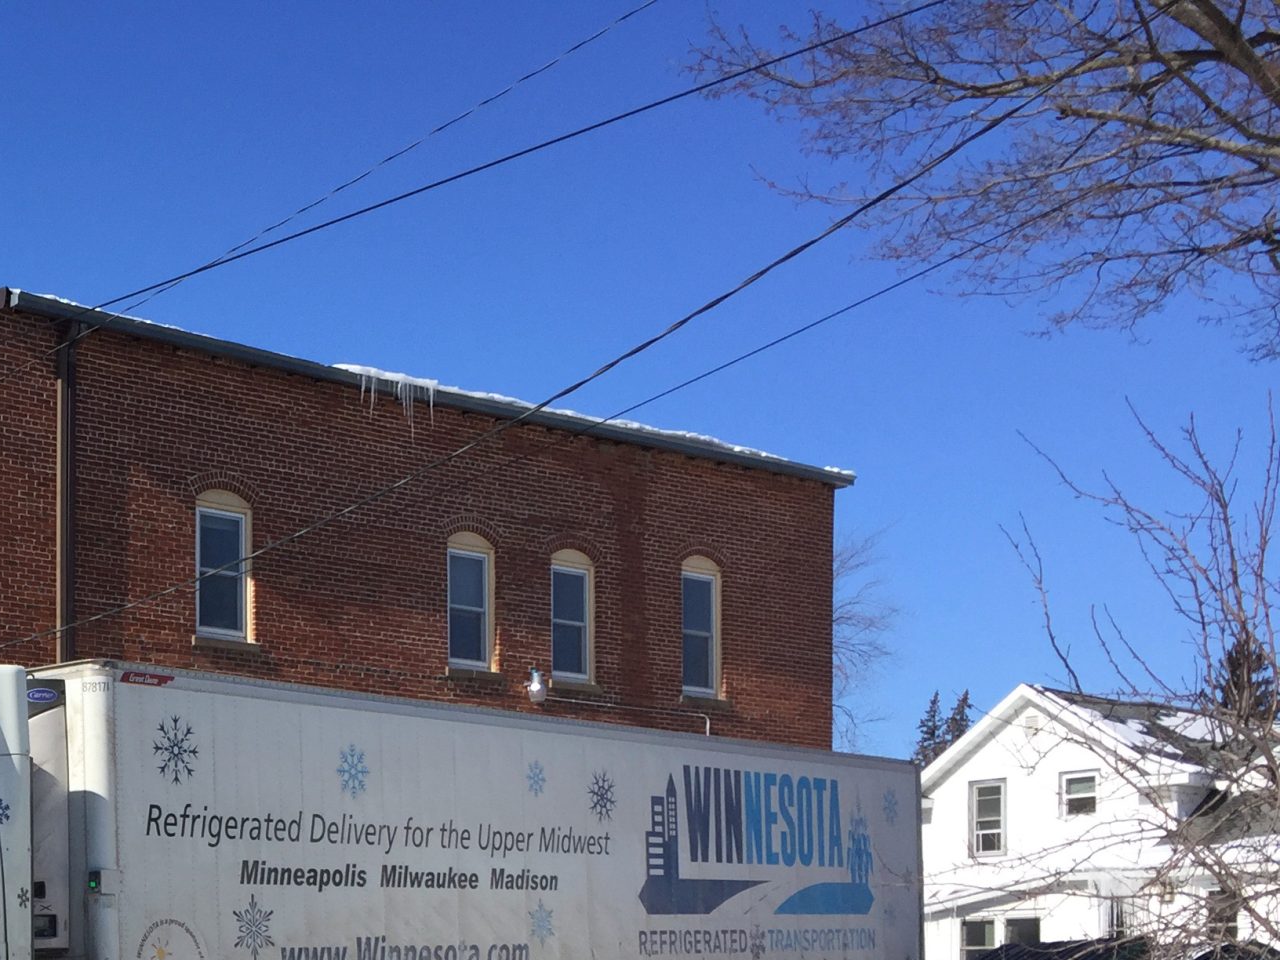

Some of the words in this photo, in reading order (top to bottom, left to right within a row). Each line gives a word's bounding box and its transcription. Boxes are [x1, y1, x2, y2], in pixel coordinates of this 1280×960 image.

[28, 690, 54, 700] Carrier
[146, 804, 302, 847] Refrigerated
[310, 813, 397, 854] Delivery
[404, 817, 434, 847] for
[440, 819, 470, 849] the
[478, 823, 534, 858] Upper
[539, 826, 611, 855] Midwest
[683, 764, 844, 867] WINNESOTA
[239, 860, 367, 892] Minneapolis
[380, 864, 479, 890] Milwaukee
[490, 868, 558, 891] Madison
[638, 929, 748, 955] REFRIGERATED
[767, 928, 876, 951] TRANSPORTATION
